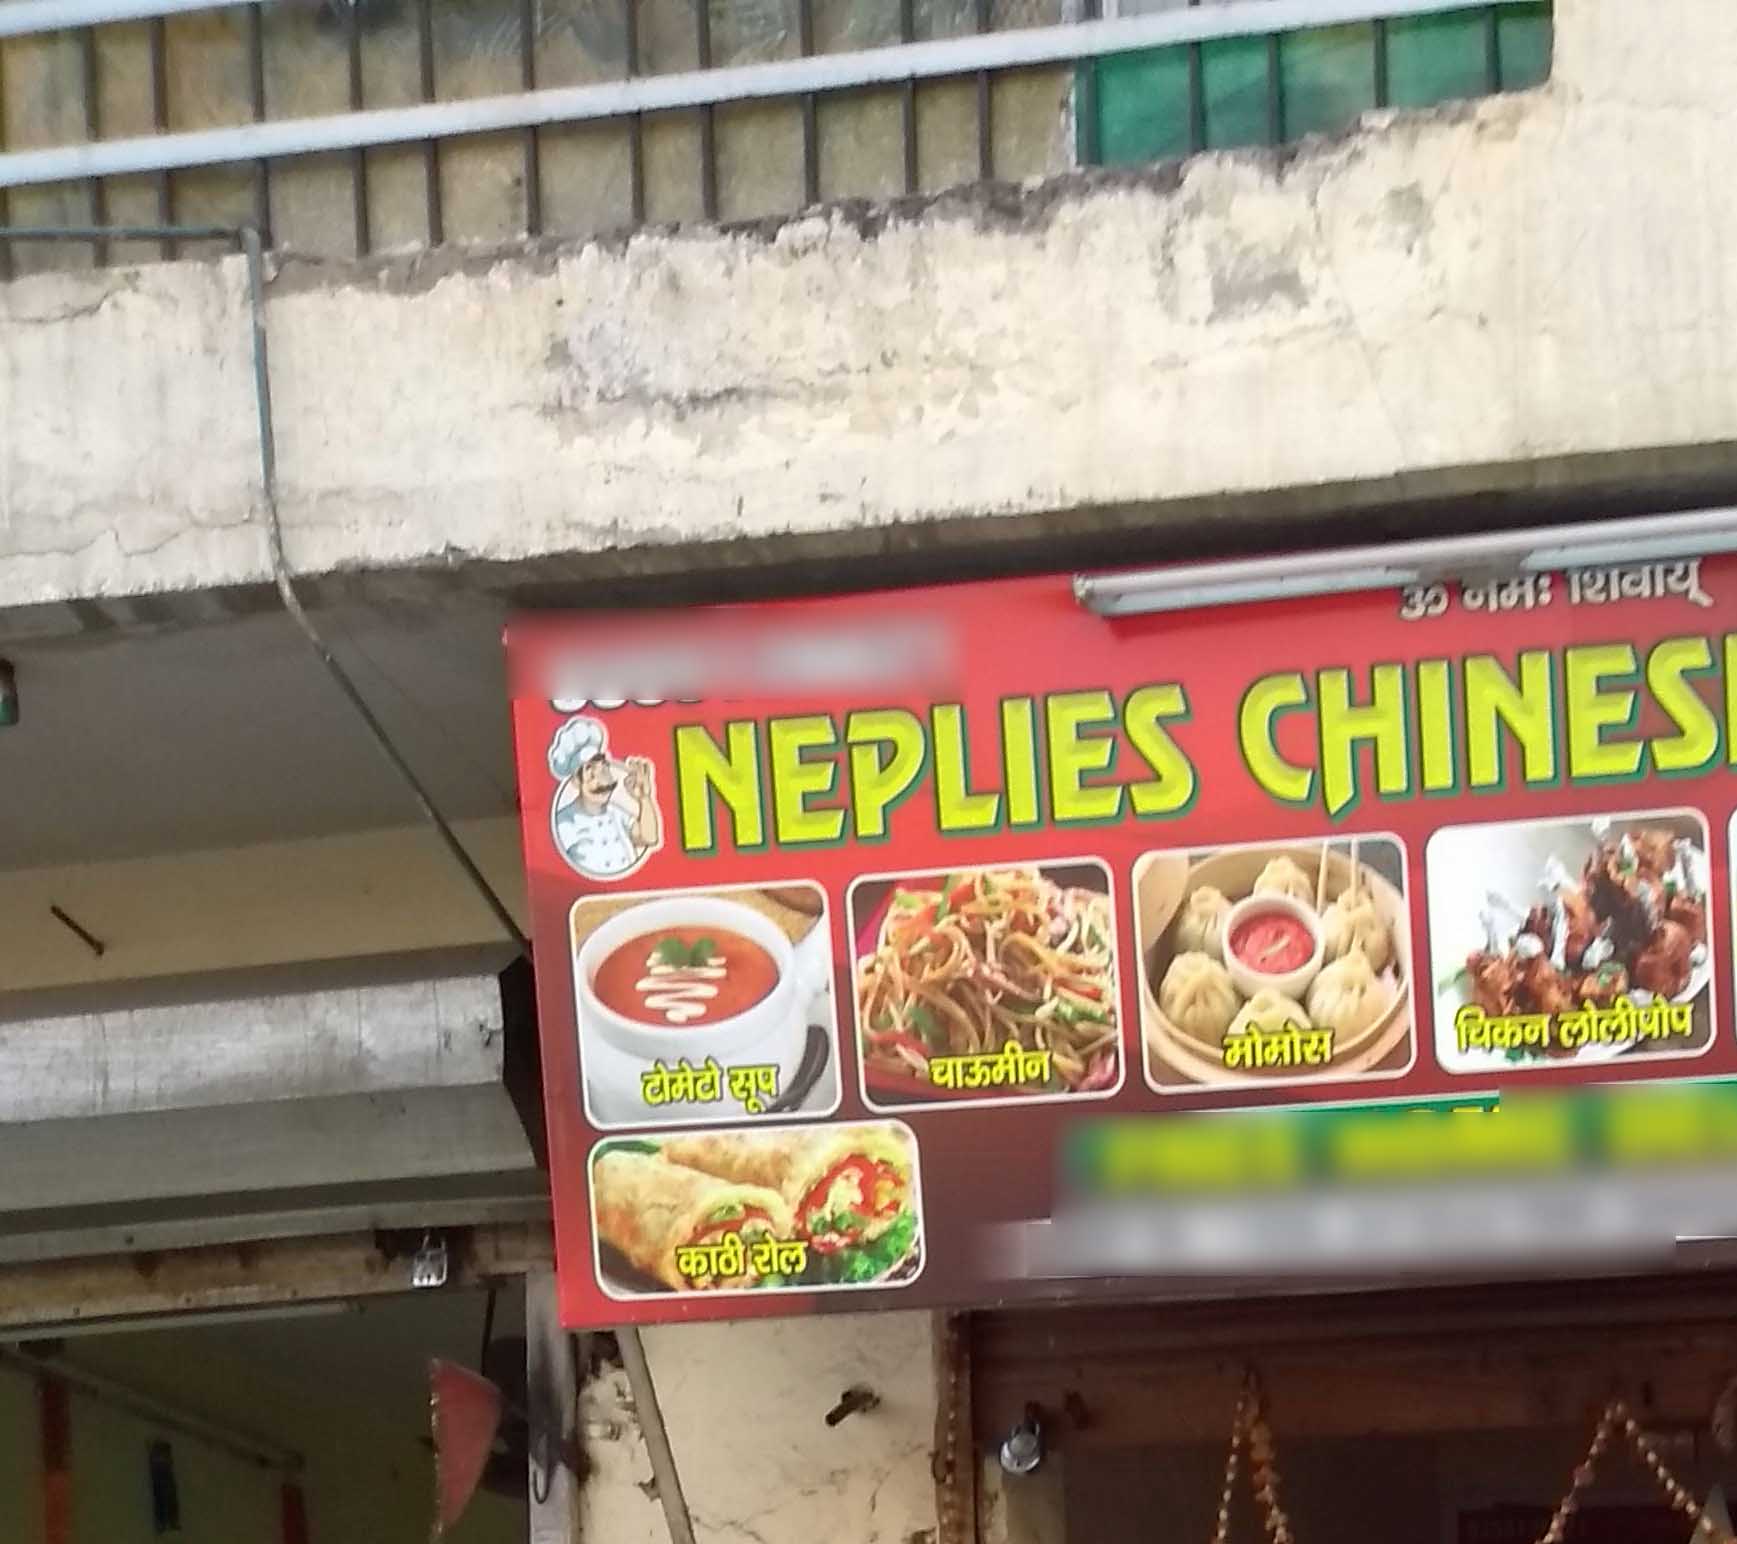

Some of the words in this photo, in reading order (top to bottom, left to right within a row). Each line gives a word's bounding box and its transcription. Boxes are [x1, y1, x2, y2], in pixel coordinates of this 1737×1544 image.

[672, 683, 1198, 856] NEPLIES
[1222, 1022, 1335, 1070] मोमोस
[1455, 1004, 1551, 1053] चिकन
[1557, 994, 1694, 1049] लोलीपोप
[641, 1057, 721, 1105] टोमेटो
[727, 1063, 779, 1113] सूप
[929, 1041, 1052, 1090] चाऊमीन
[676, 1233, 746, 1278] काठी
[750, 1238, 809, 1276] रोल
